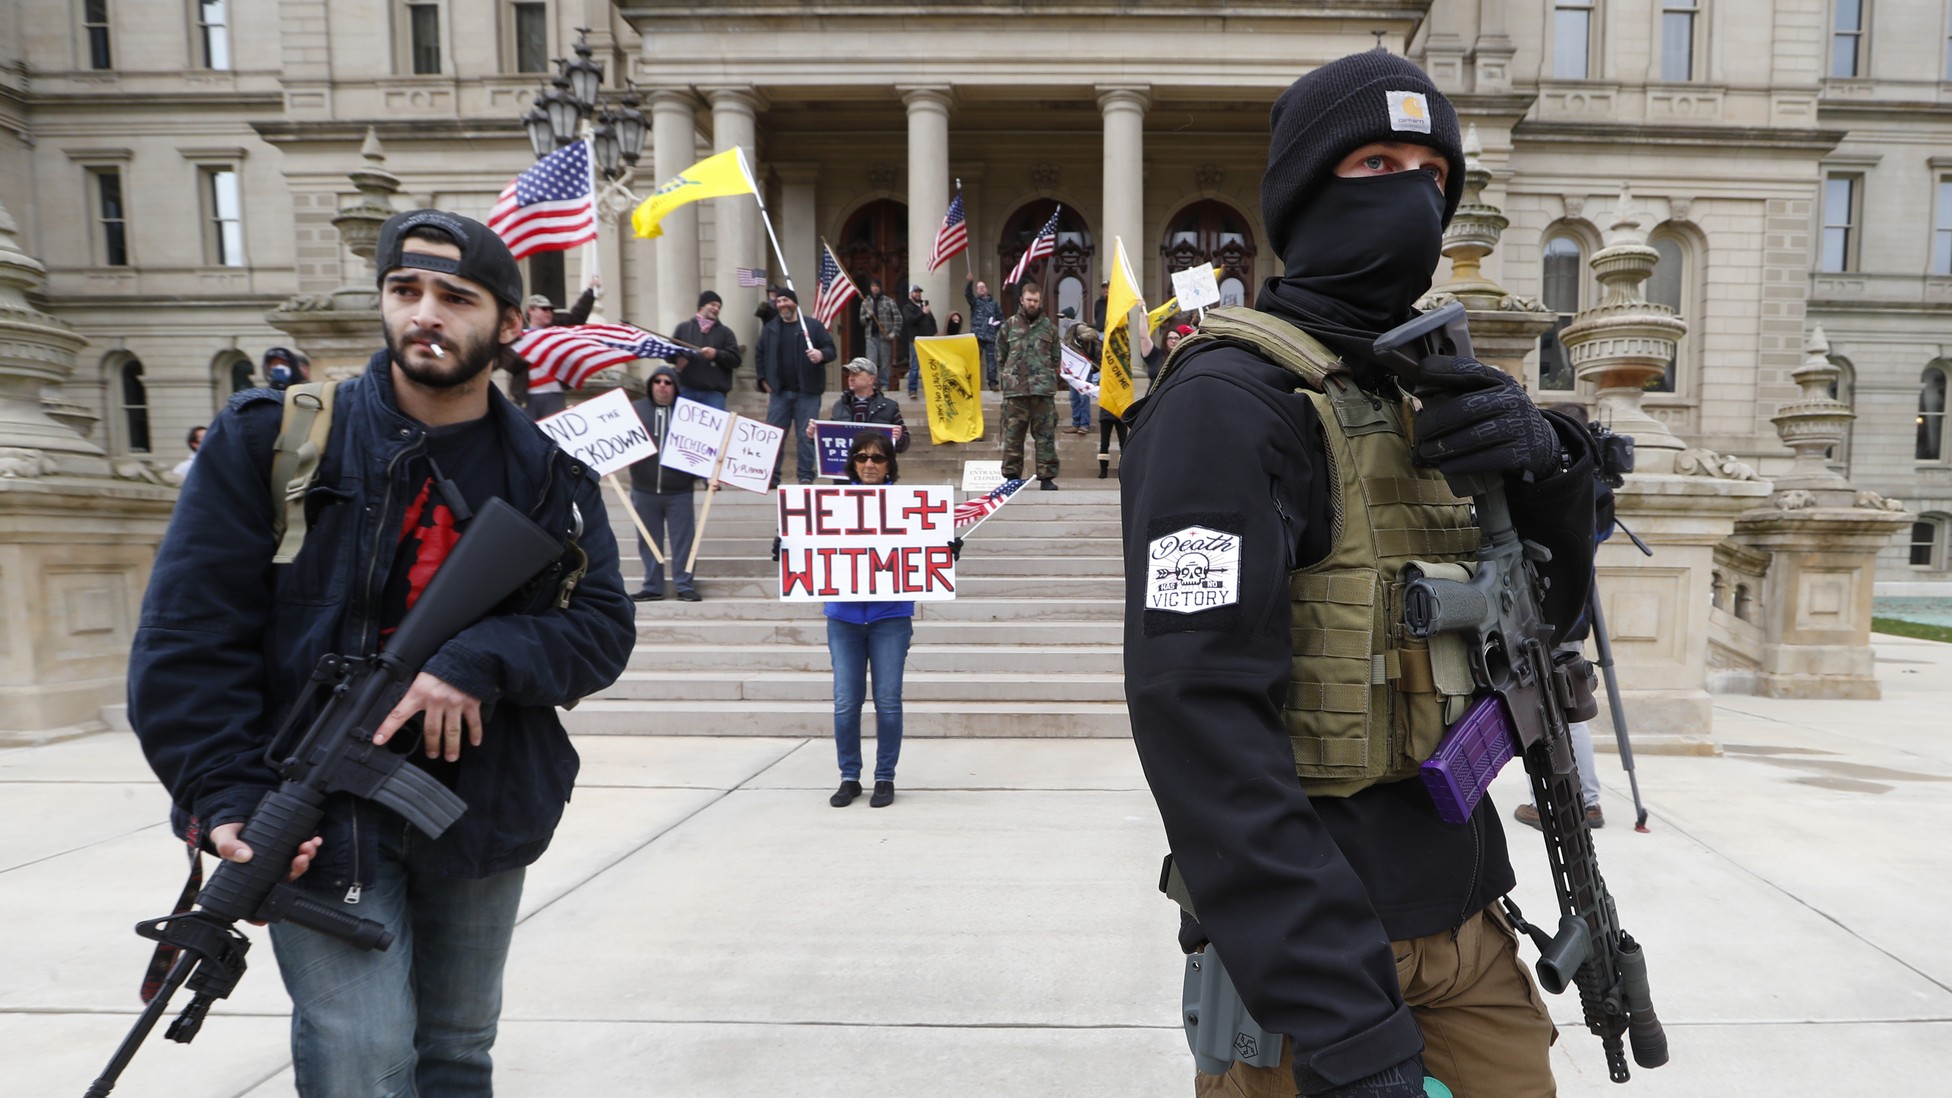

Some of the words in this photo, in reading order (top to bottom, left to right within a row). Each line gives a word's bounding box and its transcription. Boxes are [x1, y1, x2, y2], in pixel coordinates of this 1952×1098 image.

[928, 358, 937, 371] NO
[1105, 350, 1114, 365] EAD
[1111, 366, 1122, 377] ON
[1119, 378, 1130, 390] ME
[545, 413, 588, 442] ND
[597, 409, 620, 423] THE
[678, 404, 723, 432] OPEN
[737, 422, 778, 444] STOP
[574, 426, 649, 467] CKDOWN
[779, 488, 907, 535] HEIL
[1152, 535, 1236, 560] Death
[782, 547, 954, 596] WITMER
[1153, 591, 1229, 607] VICTORY
